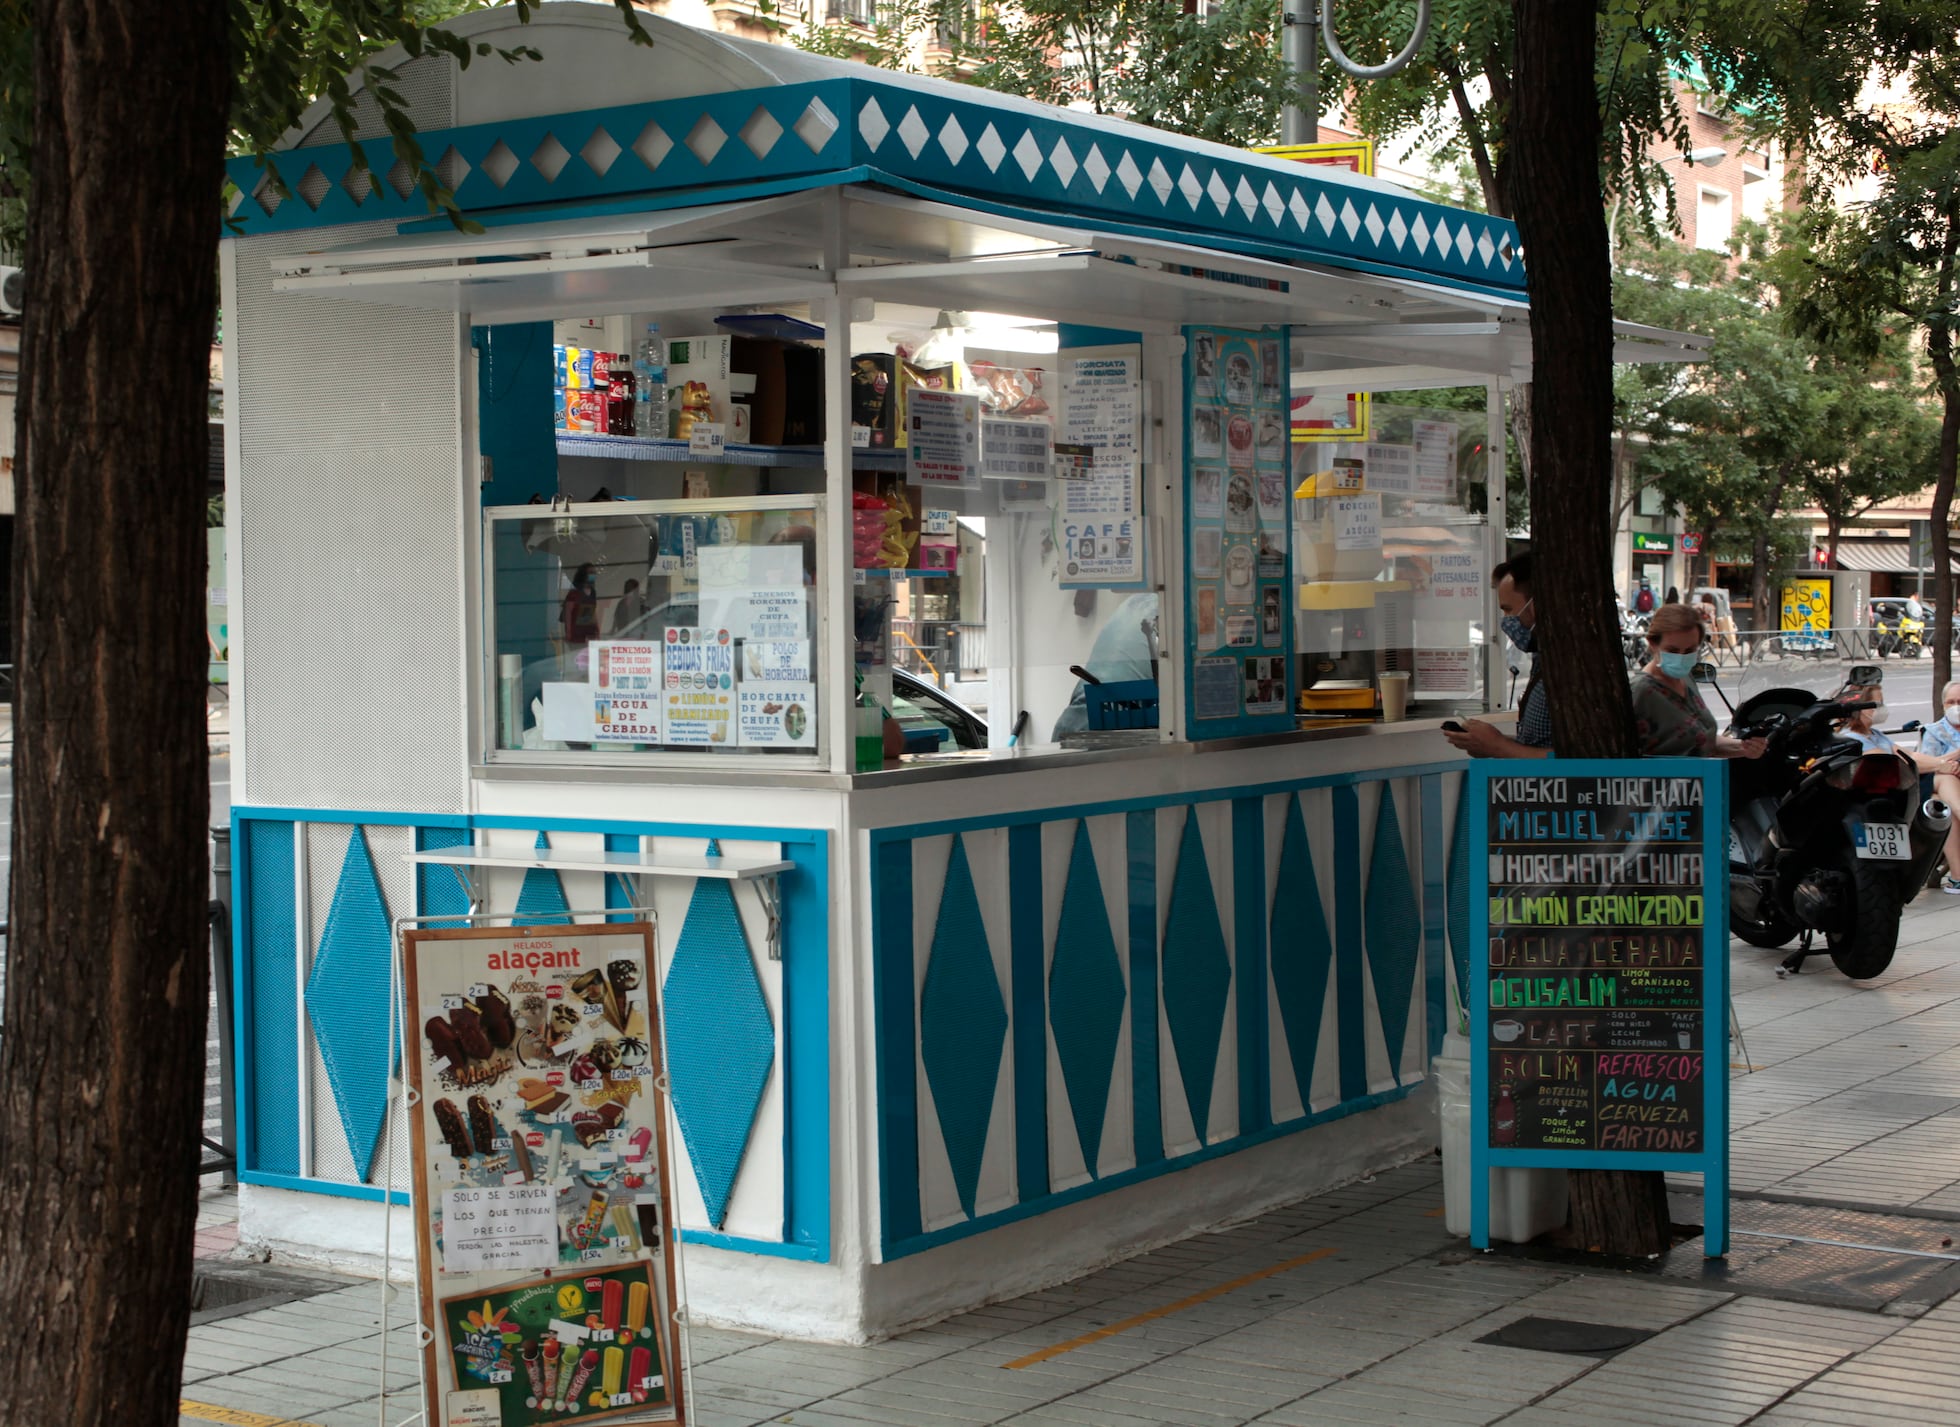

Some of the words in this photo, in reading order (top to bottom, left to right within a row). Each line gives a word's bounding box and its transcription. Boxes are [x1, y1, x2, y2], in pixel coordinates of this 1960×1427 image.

[1065, 520, 1131, 538] CAFÉ
[612, 646, 652, 654] TENEMOS
[772, 643, 798, 654] POLOS
[667, 645, 702, 671] BEBIDAS
[780, 656, 791, 668] DE
[765, 669, 808, 681] HORCHATA
[681, 692, 716, 704] LIMÓN
[742, 693, 806, 701] HORCHATA
[612, 700, 648, 709] AGUA
[742, 705, 756, 713] DE
[618, 713, 637, 721] DE
[668, 709, 729, 721] GRANIZADO
[742, 716, 780, 724] CHUFA
[602, 725, 657, 734] CEBADA
[1491, 778, 1567, 804] KIOSKO
[1578, 792, 1594, 804] DE
[1597, 778, 1703, 806] HORCHATA
[1625, 811, 1691, 840] JOSE
[1868, 827, 1904, 841] 1031
[1869, 842, 1898, 855] GXB
[1507, 854, 1624, 883] HORCHATA
[1636, 853, 1703, 884] CHUFA
[1507, 890, 1568, 925] LIMÓN
[1576, 892, 1703, 925] GRANIZADO
[513, 941, 553, 950] HELADOS
[1508, 936, 1568, 966] AGUA
[1591, 936, 1697, 966] CEBADA
[487, 948, 581, 975] alaçant
[1622, 969, 1650, 977] LIMÓN
[1631, 976, 1690, 987] GRANIZADO
[456, 1057, 513, 1088] Magic
[1598, 1053, 1702, 1082] REFRESCOS
[1603, 1078, 1676, 1102] AGUA
[1538, 1098, 1589, 1109] CERVEZA
[1599, 1104, 1689, 1123] CERVEZA
[1541, 1118, 1568, 1127] TOQUE
[1601, 1124, 1698, 1150] FARTONS
[453, 1192, 479, 1202] SOLO
[488, 1191, 500, 1200] SE
[508, 1189, 547, 1199] SIRVEN
[454, 1212, 475, 1221] LOS
[489, 1209, 509, 1218] QUE
[514, 1208, 551, 1216] TIENEN
[473, 1225, 517, 1235] PRECIO
[465, 1332, 491, 1347] ICE
